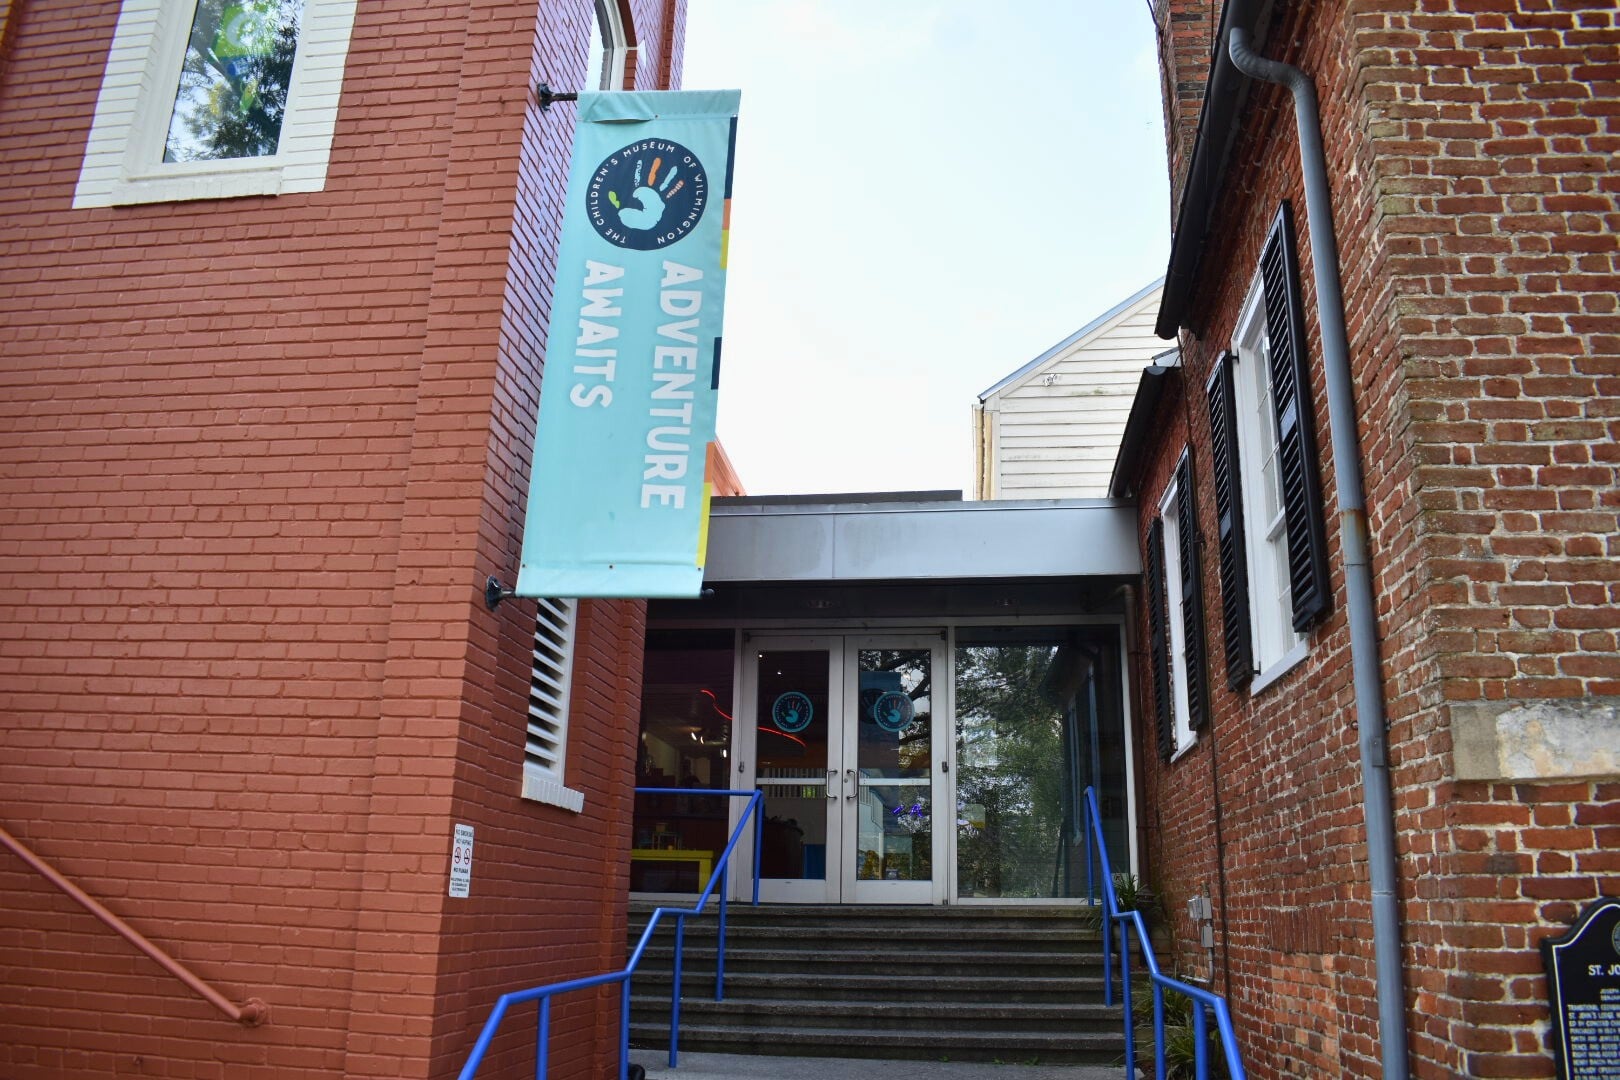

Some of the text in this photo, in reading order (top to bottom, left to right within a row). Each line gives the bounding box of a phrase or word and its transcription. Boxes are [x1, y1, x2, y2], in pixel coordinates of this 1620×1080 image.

[590, 141, 704, 245] THE CHILDREN'S MUSEUM OF WILMINGTON
[569, 259, 625, 408] AWAITS
[640, 259, 704, 510] ADVENTURE
[1588, 964, 1604, 976] ST.
